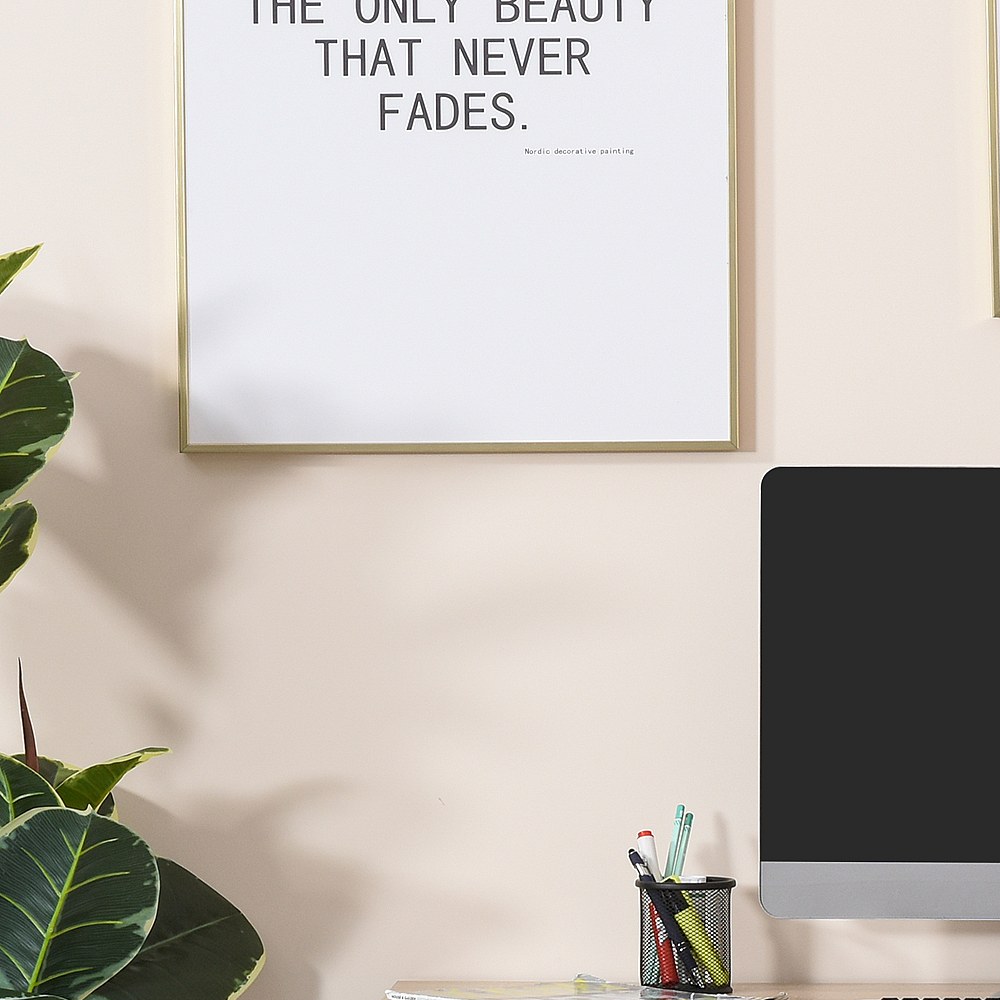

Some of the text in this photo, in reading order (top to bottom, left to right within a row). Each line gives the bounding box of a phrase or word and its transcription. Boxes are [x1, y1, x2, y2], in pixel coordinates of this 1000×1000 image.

[252, 0, 655, 24] THE ONLY BEAUTY
[315, 38, 591, 76] THAT NEVER
[379, 92, 528, 131] FADES.
[554, 147, 597, 155] decorative
[600, 147, 635, 156] painting
